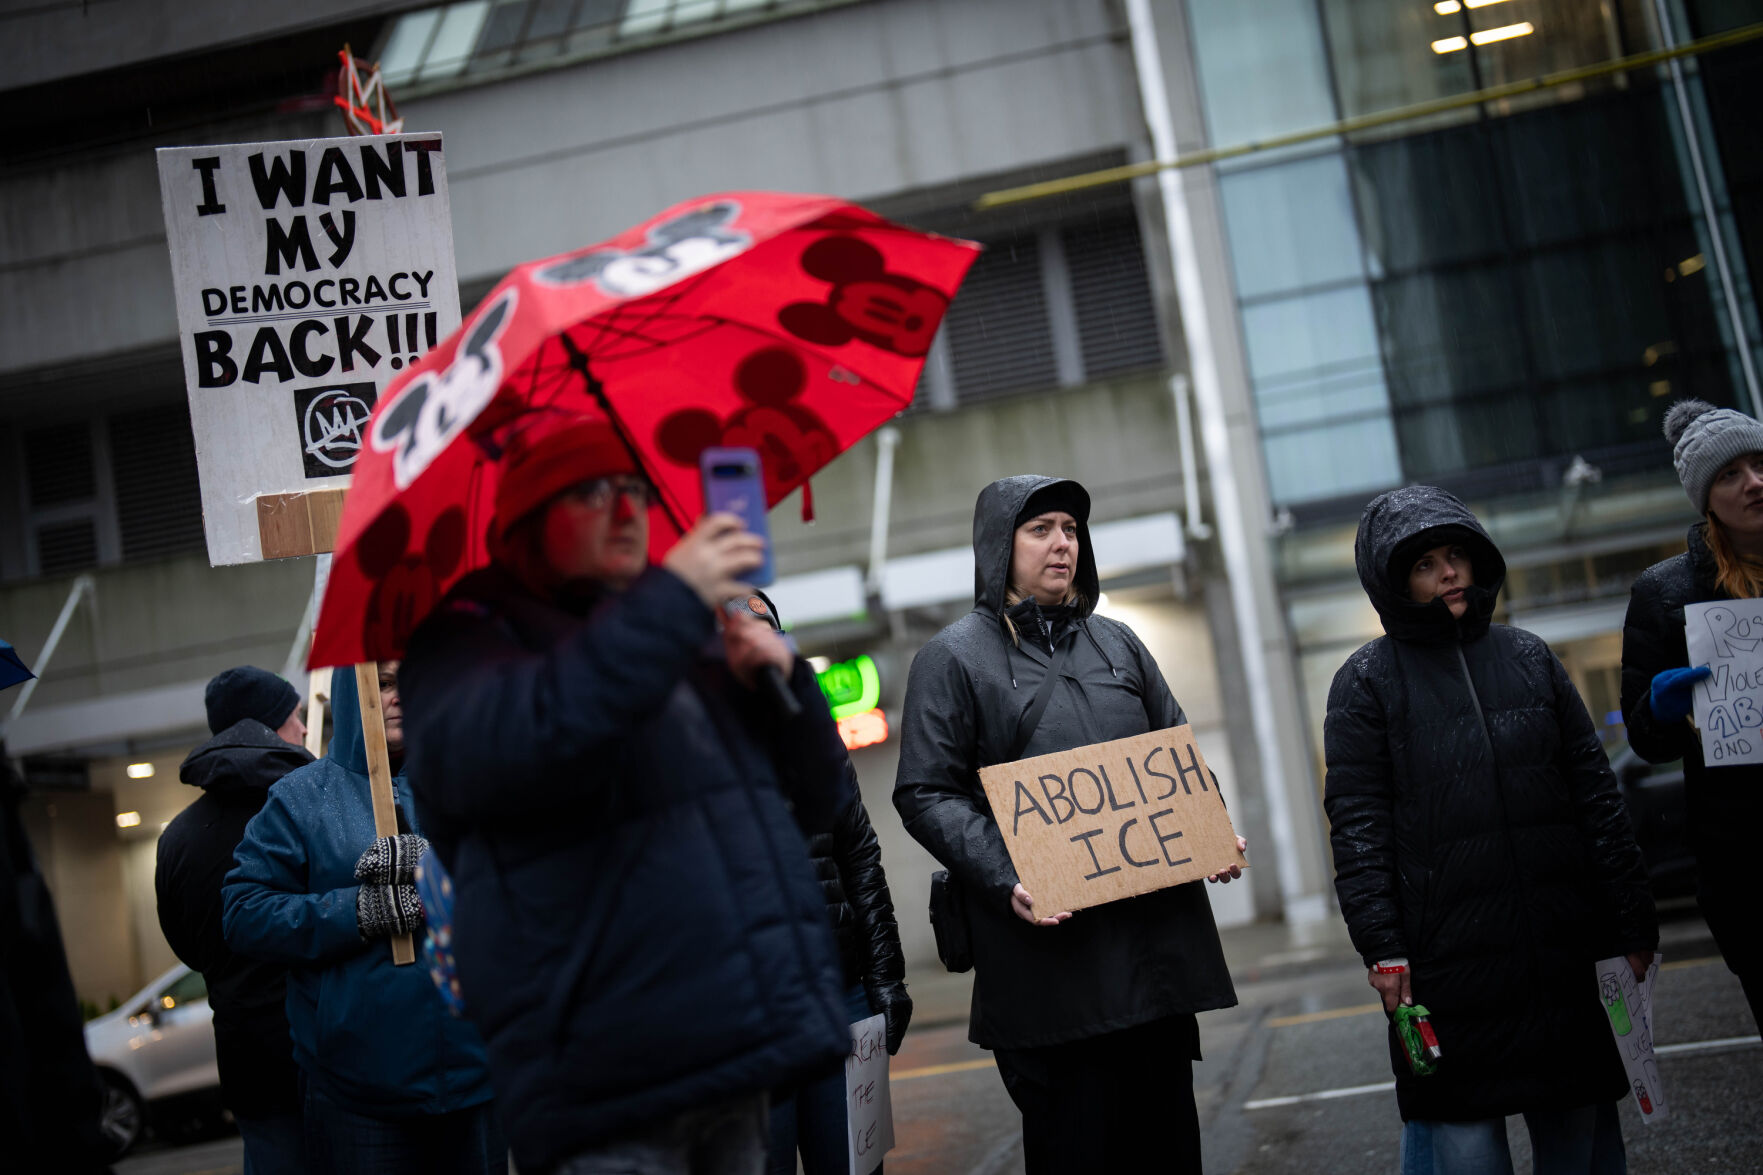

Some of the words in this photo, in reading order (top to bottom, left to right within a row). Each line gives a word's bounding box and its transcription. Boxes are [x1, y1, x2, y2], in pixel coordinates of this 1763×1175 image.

[192, 156, 227, 217] I
[248, 139, 442, 211] WANT
[264, 209, 356, 276] MY
[201, 270, 434, 317] DEMOCRACY
[193, 311, 438, 389] BACK!!!
[1708, 697, 1763, 739] AB
[1013, 743, 1209, 836] ABOLISH
[1069, 808, 1192, 881] ICE
[848, 1030, 888, 1070] REAK
